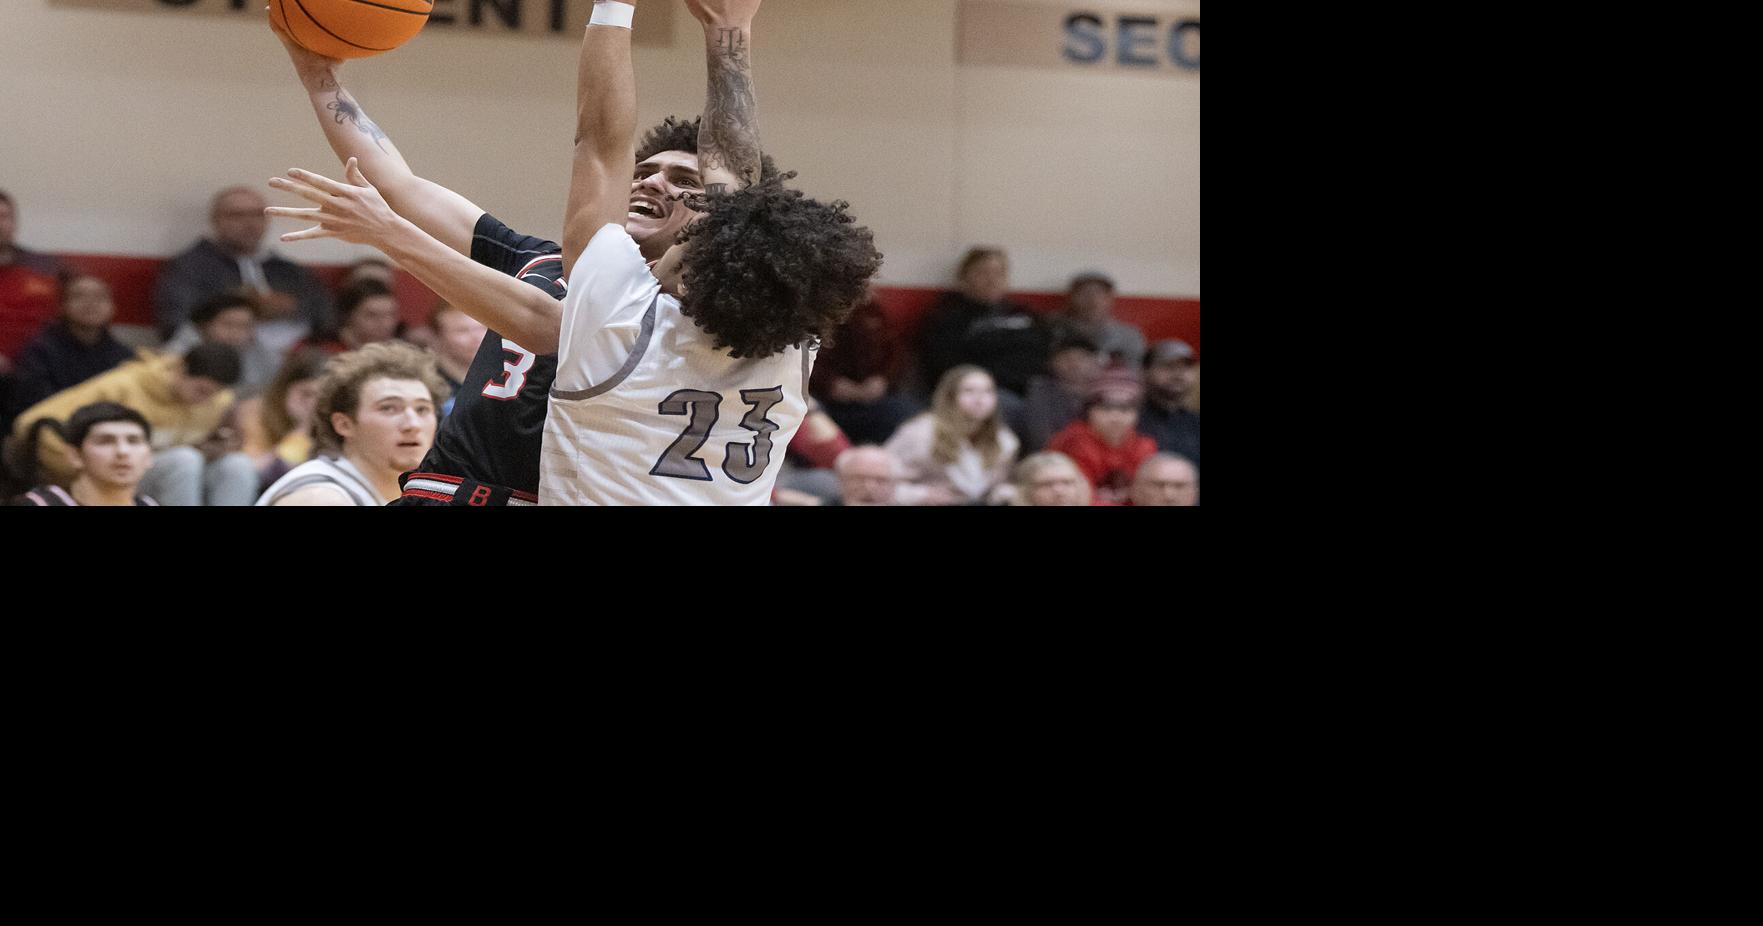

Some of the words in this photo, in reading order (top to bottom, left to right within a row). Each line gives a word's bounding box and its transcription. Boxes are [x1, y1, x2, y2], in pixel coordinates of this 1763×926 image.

[481, 338, 536, 400] 3
[649, 385, 784, 484] 23
[468, 485, 492, 506] B
